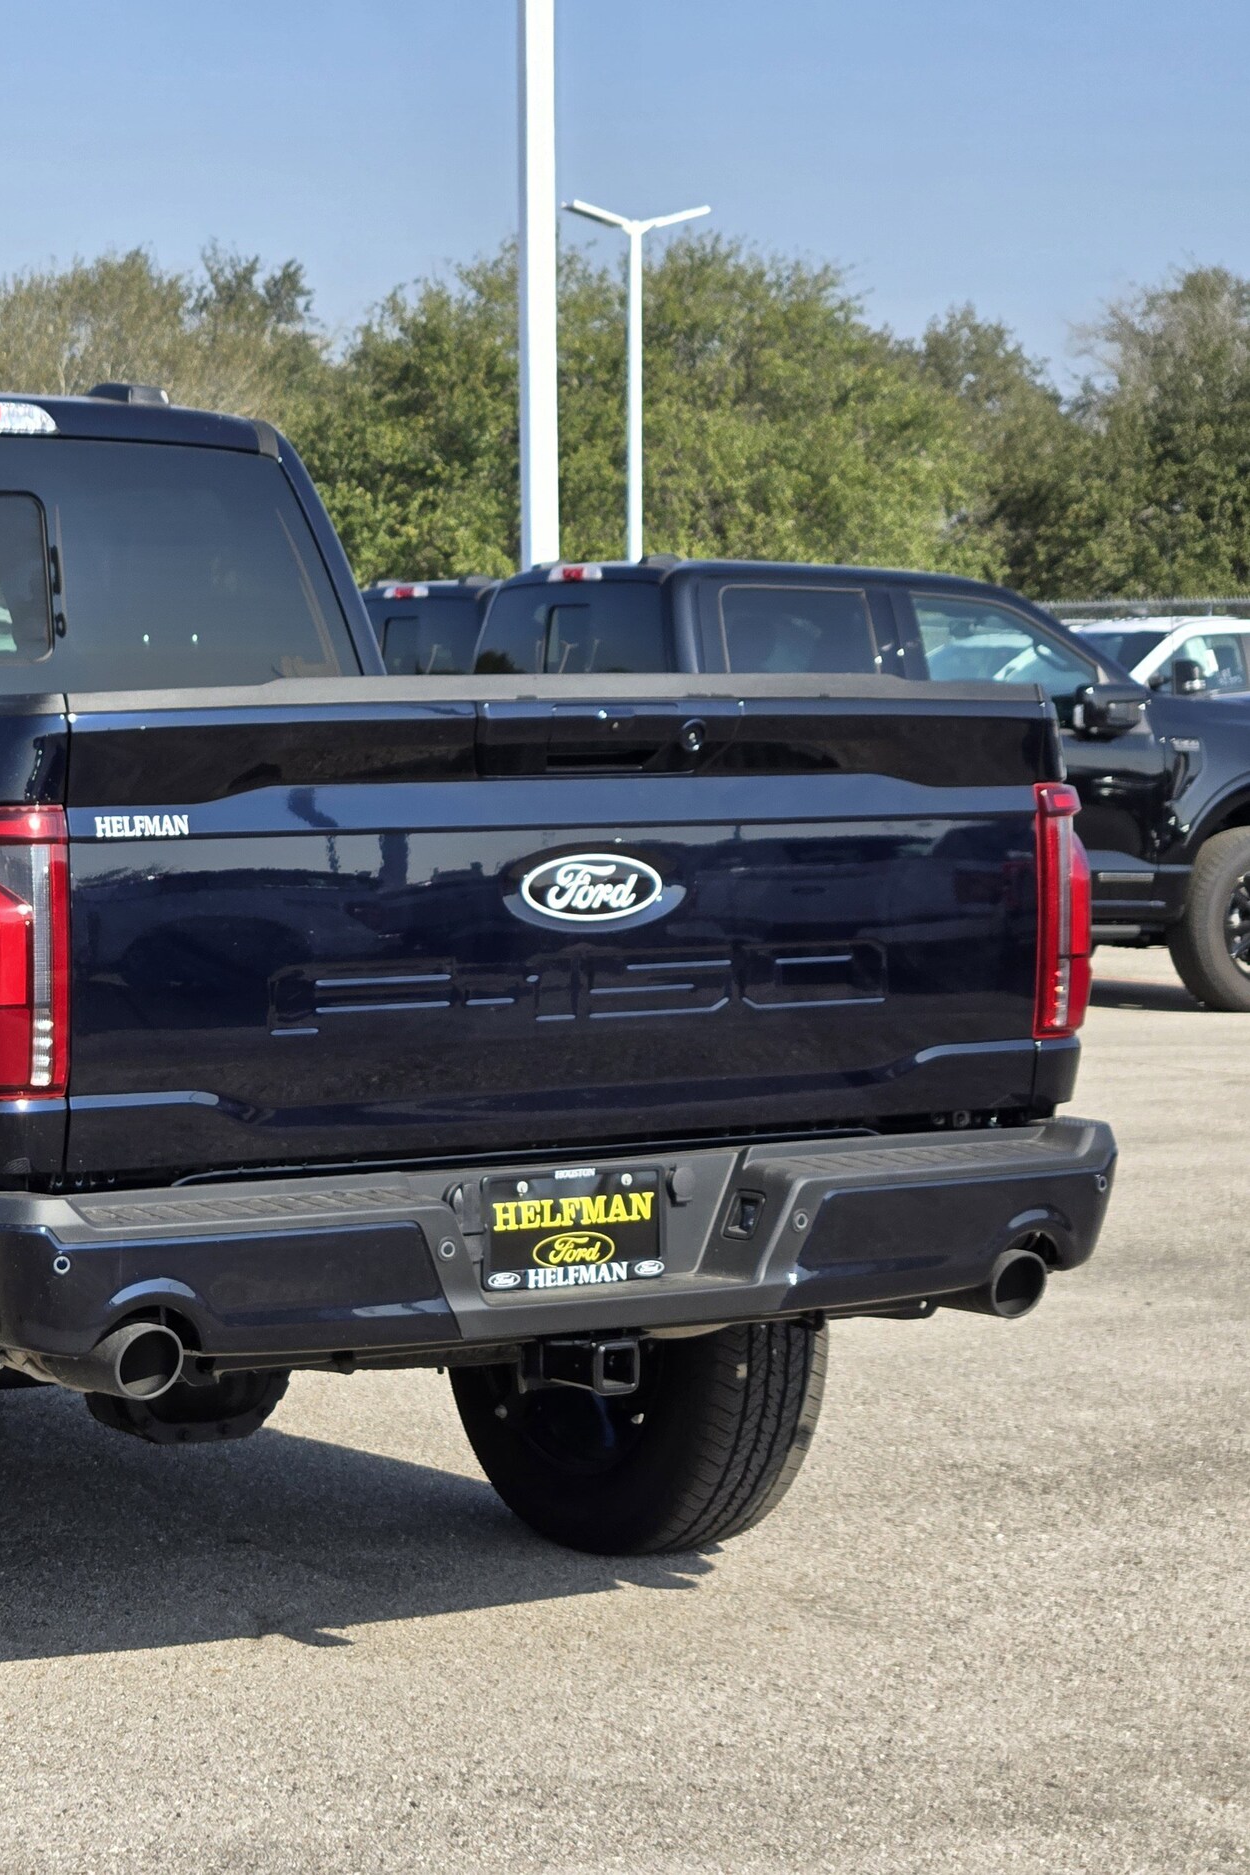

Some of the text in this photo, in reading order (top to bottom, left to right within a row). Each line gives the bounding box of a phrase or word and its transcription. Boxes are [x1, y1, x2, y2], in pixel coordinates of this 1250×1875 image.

[94, 814, 190, 838] HELFMAN
[547, 863, 638, 910] Ford
[492, 1191, 655, 1232] HELFMAN
[549, 1236, 602, 1264] Ford
[527, 1261, 629, 1289] HELFMAN
